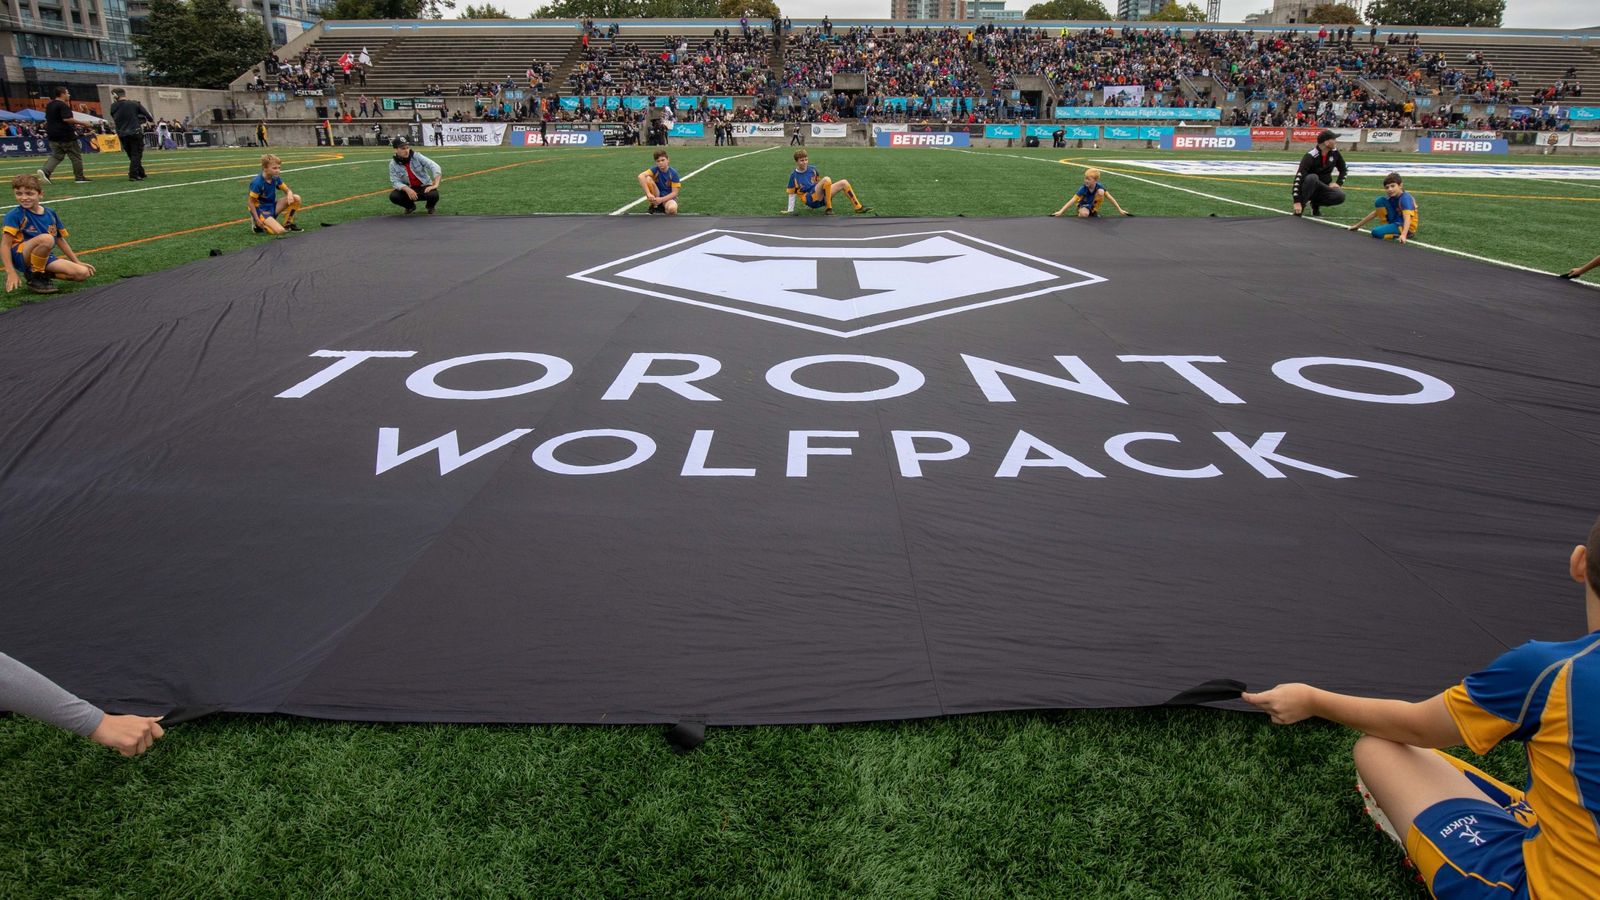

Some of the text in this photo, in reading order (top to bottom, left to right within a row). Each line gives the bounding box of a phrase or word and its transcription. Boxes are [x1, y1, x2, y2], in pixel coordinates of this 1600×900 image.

[447, 134, 472, 143] CHANGER
[474, 134, 487, 143] ZONE
[893, 134, 954, 145] BETFRED
[1175, 137, 1235, 148] BETFRED
[1433, 140, 1492, 152] BETFRED
[274, 350, 1455, 404] TORONTO
[376, 428, 1356, 478] WOLFPACK
[1440, 815, 1479, 838] KUKRI
